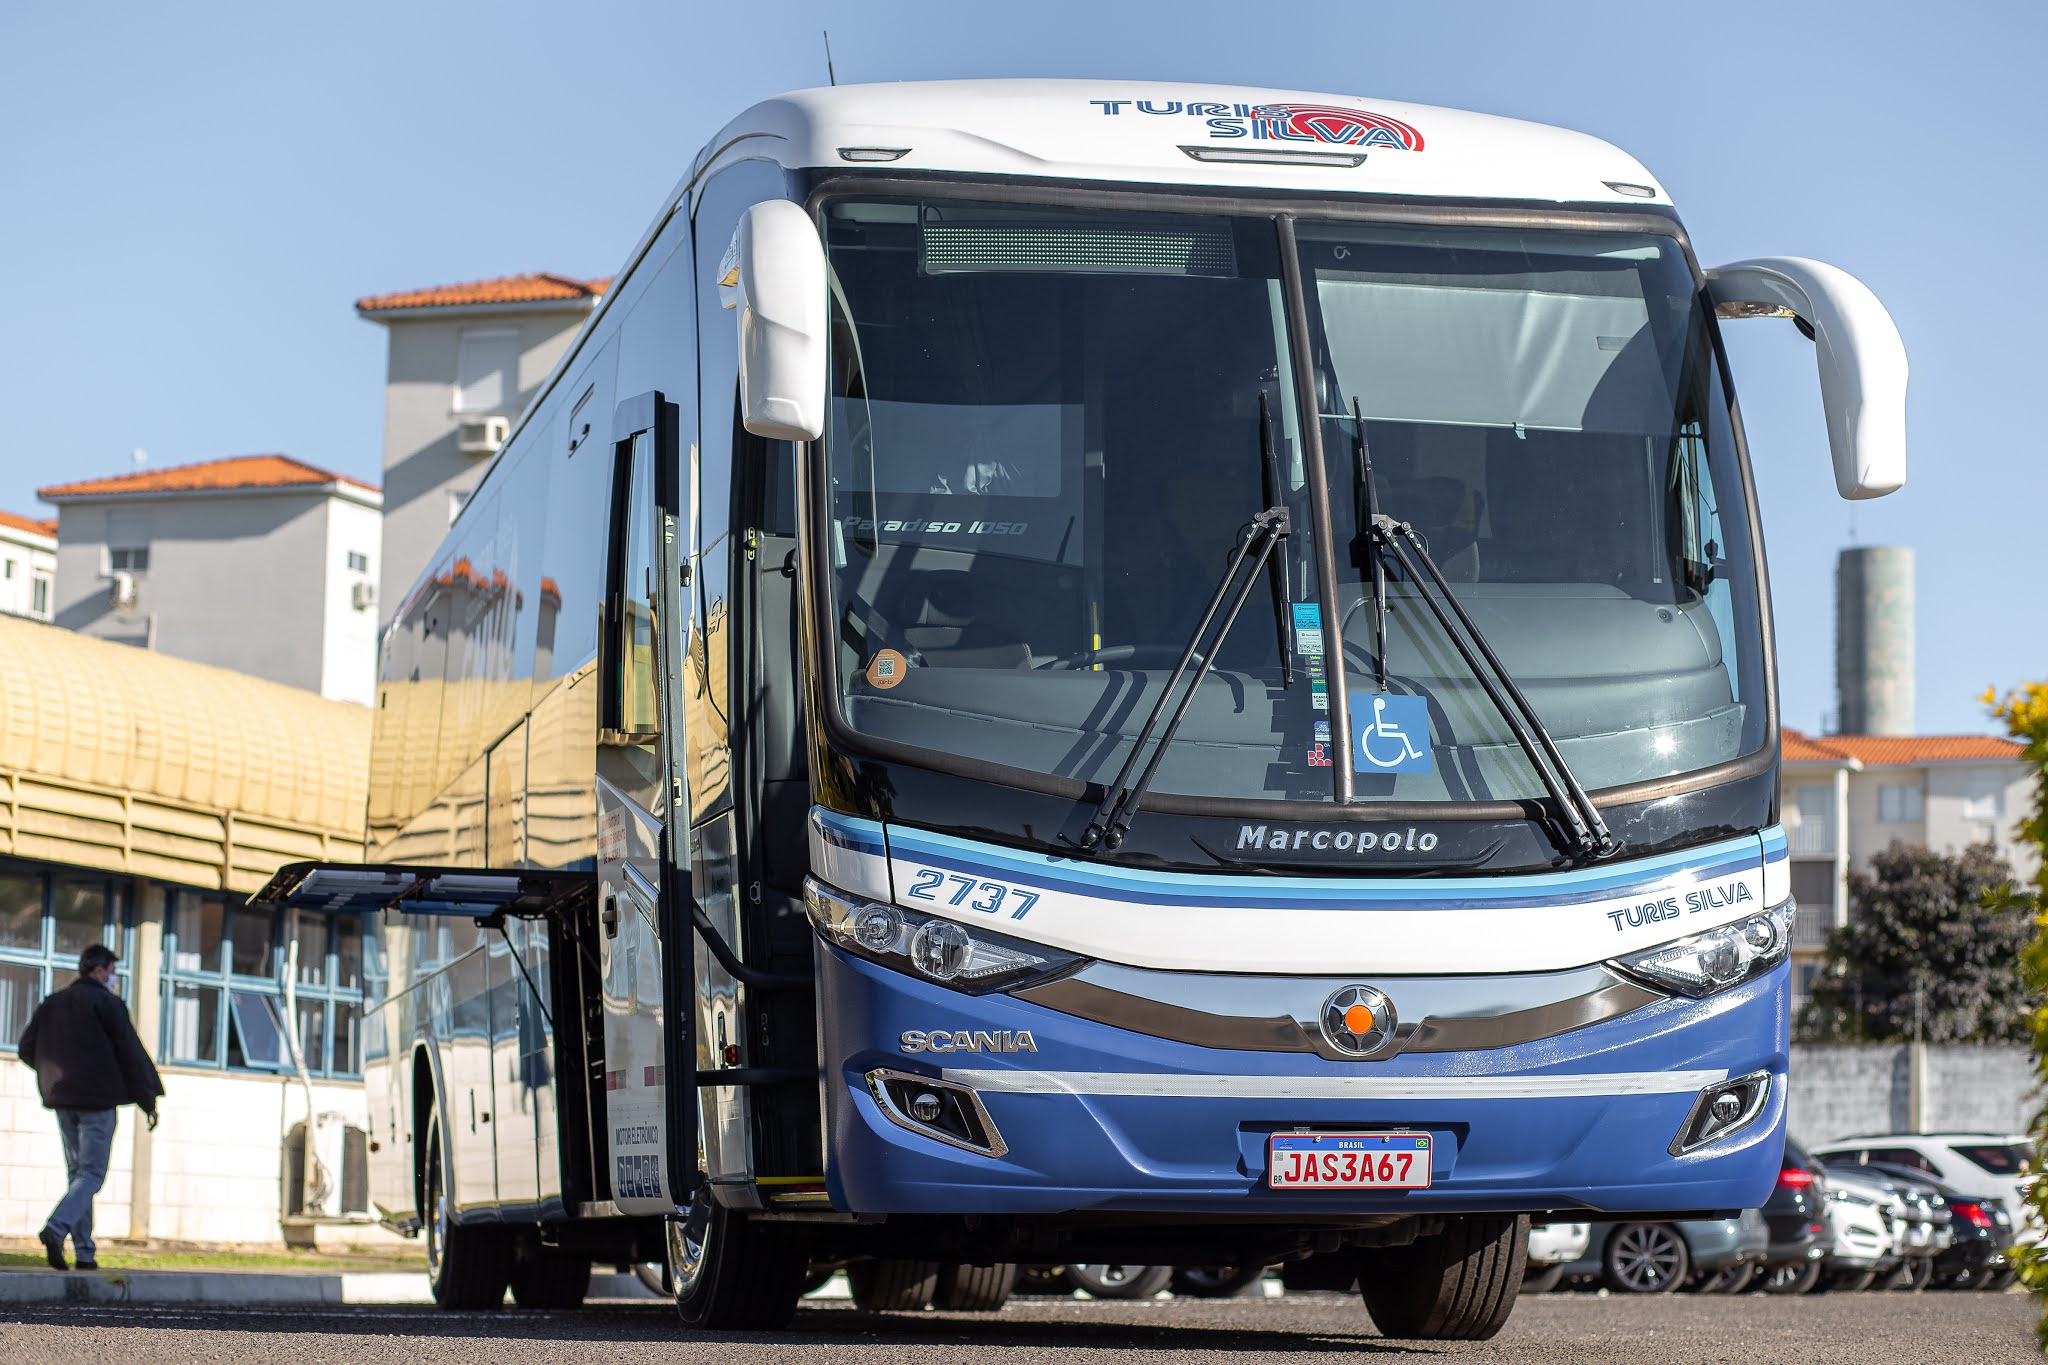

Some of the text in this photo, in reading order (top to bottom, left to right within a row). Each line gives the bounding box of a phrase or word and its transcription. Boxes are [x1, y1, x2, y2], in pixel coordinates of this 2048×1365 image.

[1090, 101, 1293, 118] TURIS
[1206, 118, 1410, 150] SILVA
[1235, 825, 1438, 854] Marcopolo
[907, 869, 1041, 921] 2737
[1607, 881, 1753, 931] TURIS SILVA
[900, 1030, 1039, 1053] SCANIA
[615, 1127, 632, 1146] MOTOR
[1338, 1141, 1364, 1149] BRASIL
[1273, 1175, 1283, 1184] BR
[1284, 1153, 1413, 1182] JAS3A67
